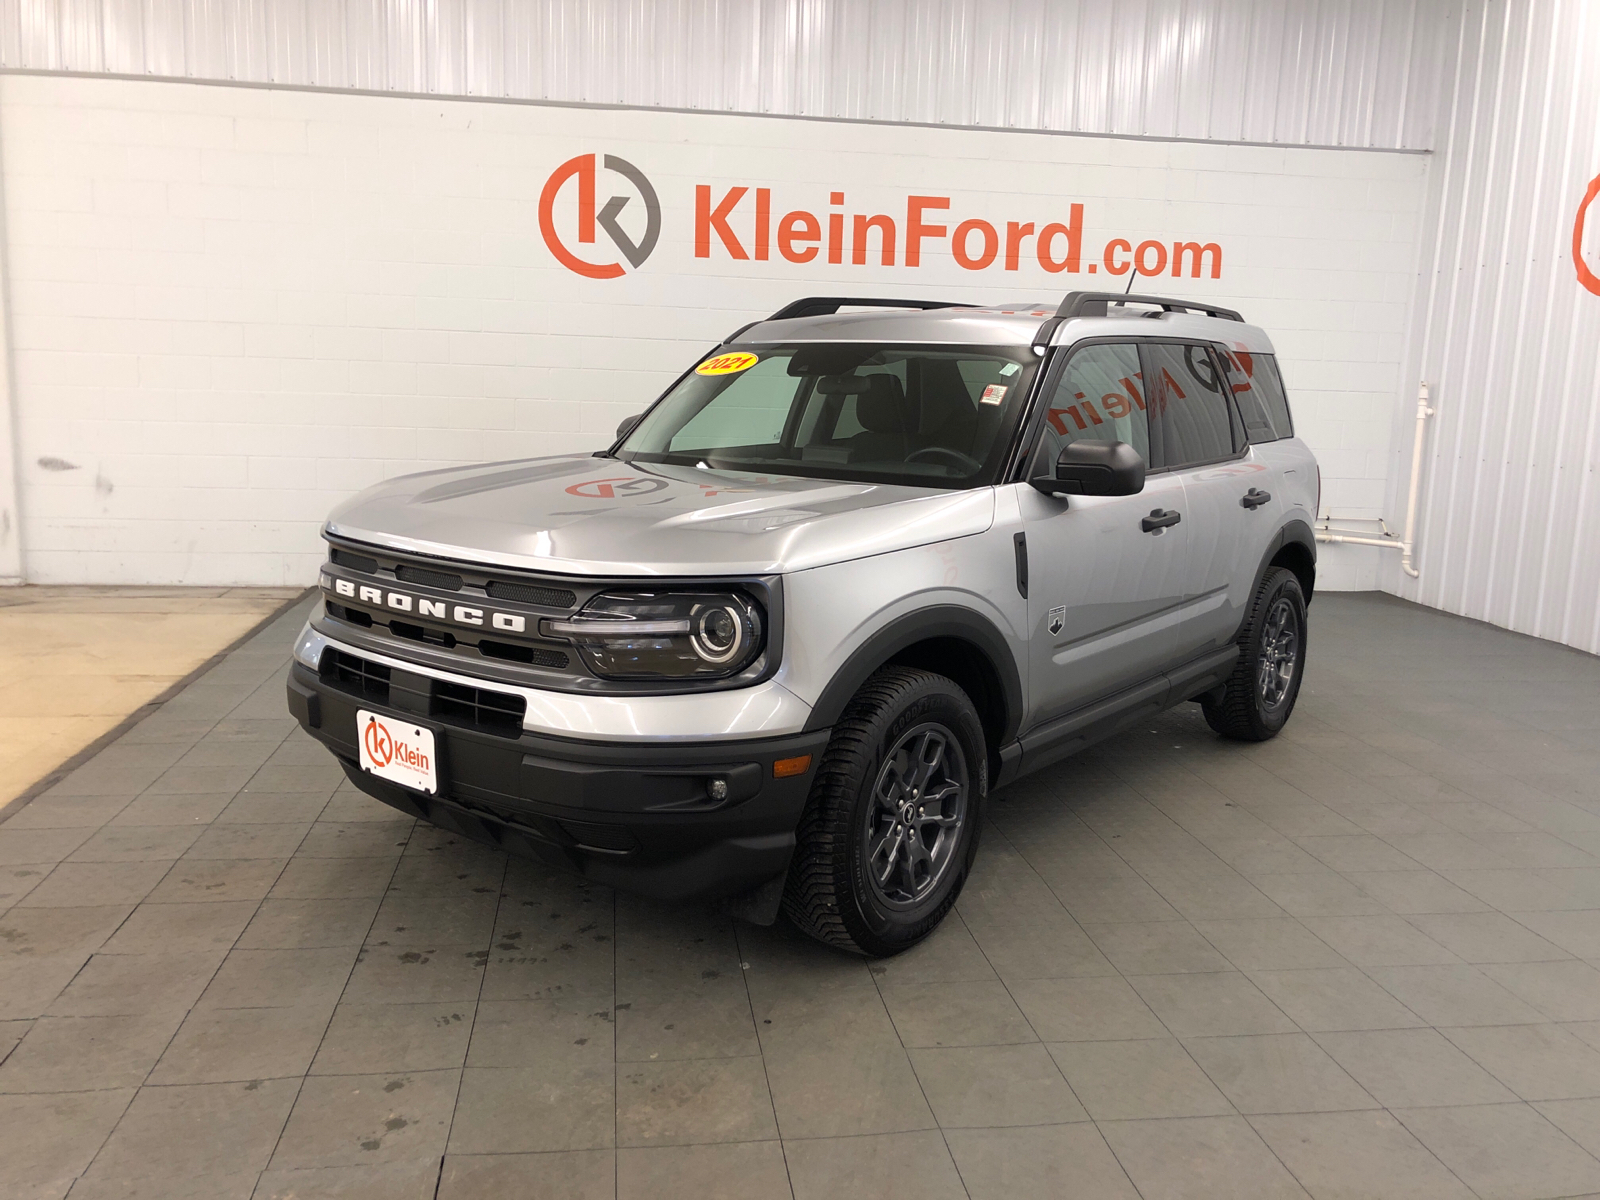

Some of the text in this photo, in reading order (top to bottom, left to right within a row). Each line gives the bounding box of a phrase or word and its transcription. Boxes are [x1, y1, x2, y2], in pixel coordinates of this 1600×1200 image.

[694, 184, 1223, 279] KleinFord.com
[698, 356, 753, 370] 2021
[335, 579, 526, 632] BRONCO
[394, 740, 429, 770] Klein
